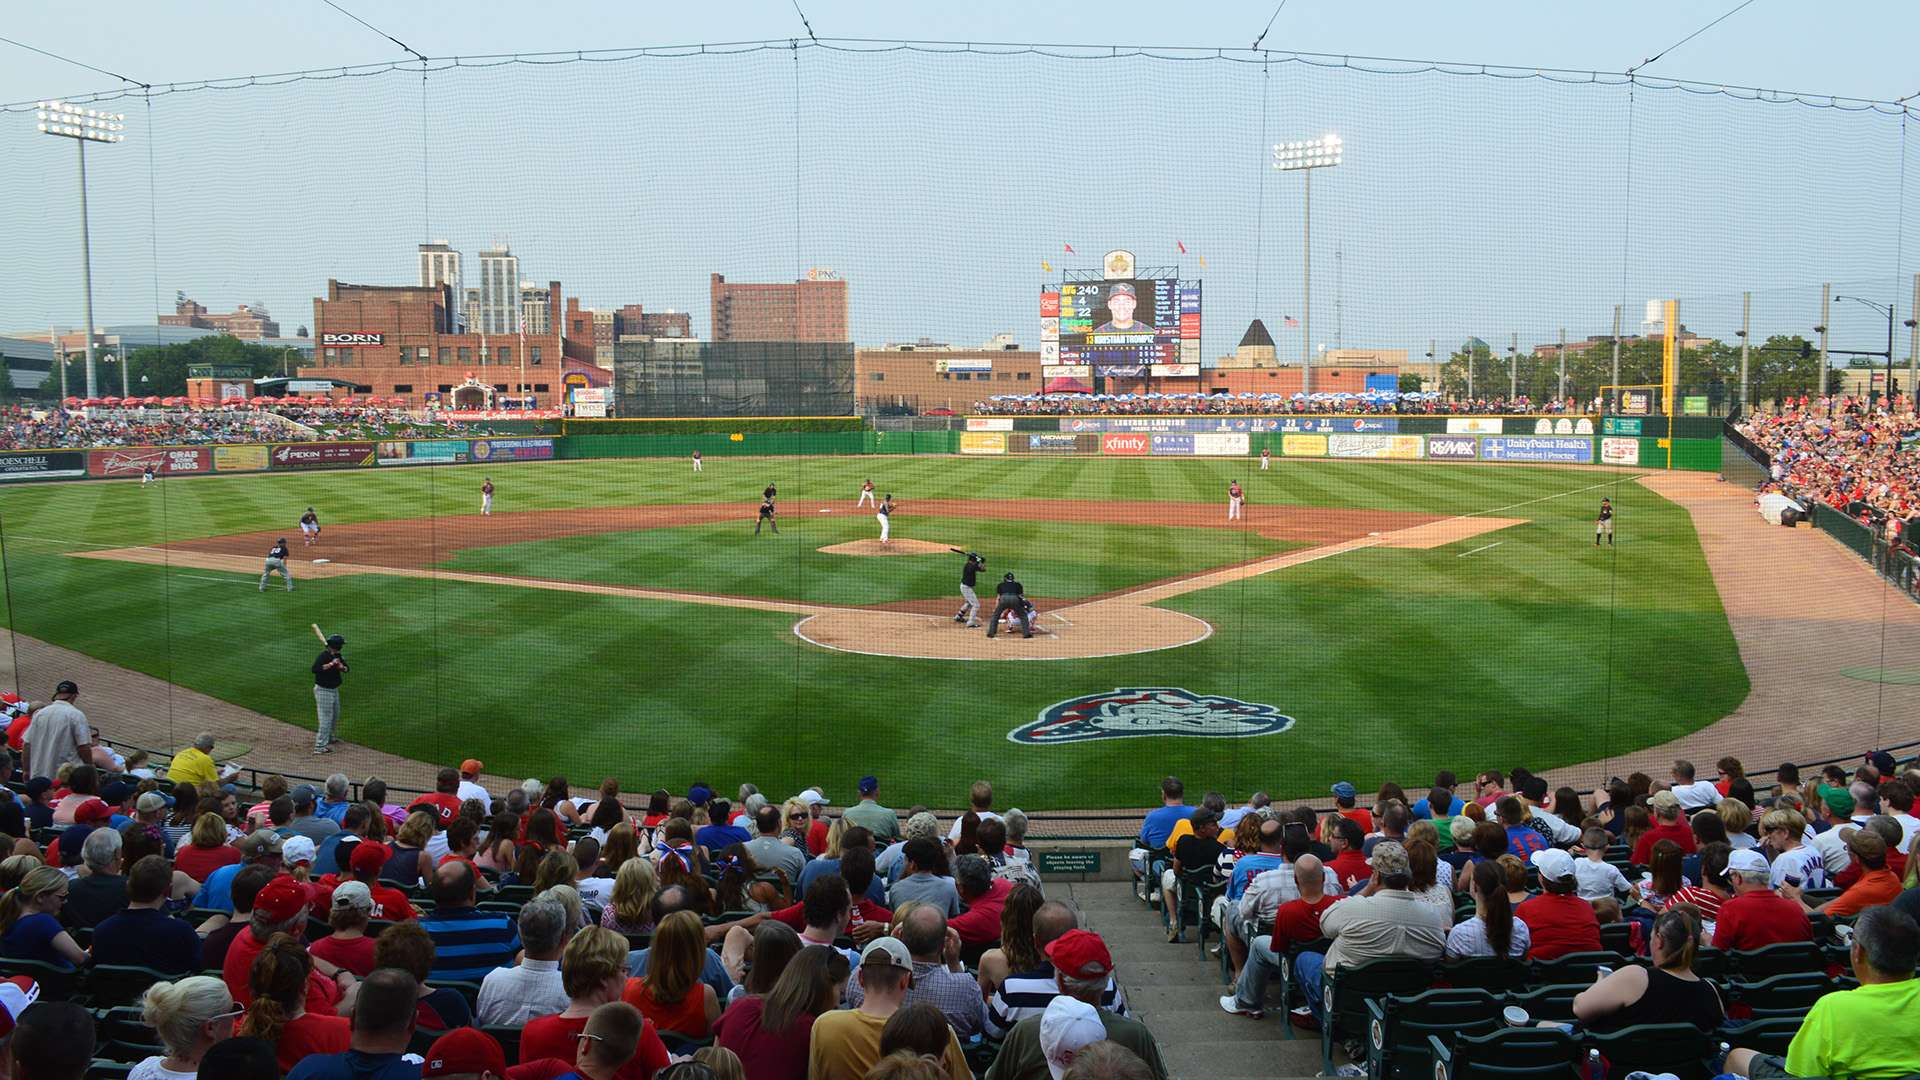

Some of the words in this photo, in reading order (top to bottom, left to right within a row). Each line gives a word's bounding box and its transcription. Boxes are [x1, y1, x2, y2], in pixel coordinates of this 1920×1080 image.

[1078, 307, 1092, 317] 22
[323, 334, 380, 342] BORN
[1105, 437, 1146, 451] xfinity
[1430, 441, 1475, 455] RE/MAX
[1506, 439, 1555, 449] UnityPoint
[1556, 439, 1588, 448] Health
[169, 451, 199, 459] GRAB
[289, 451, 320, 459] PEKIN
[170, 462, 199, 470] BUDS
